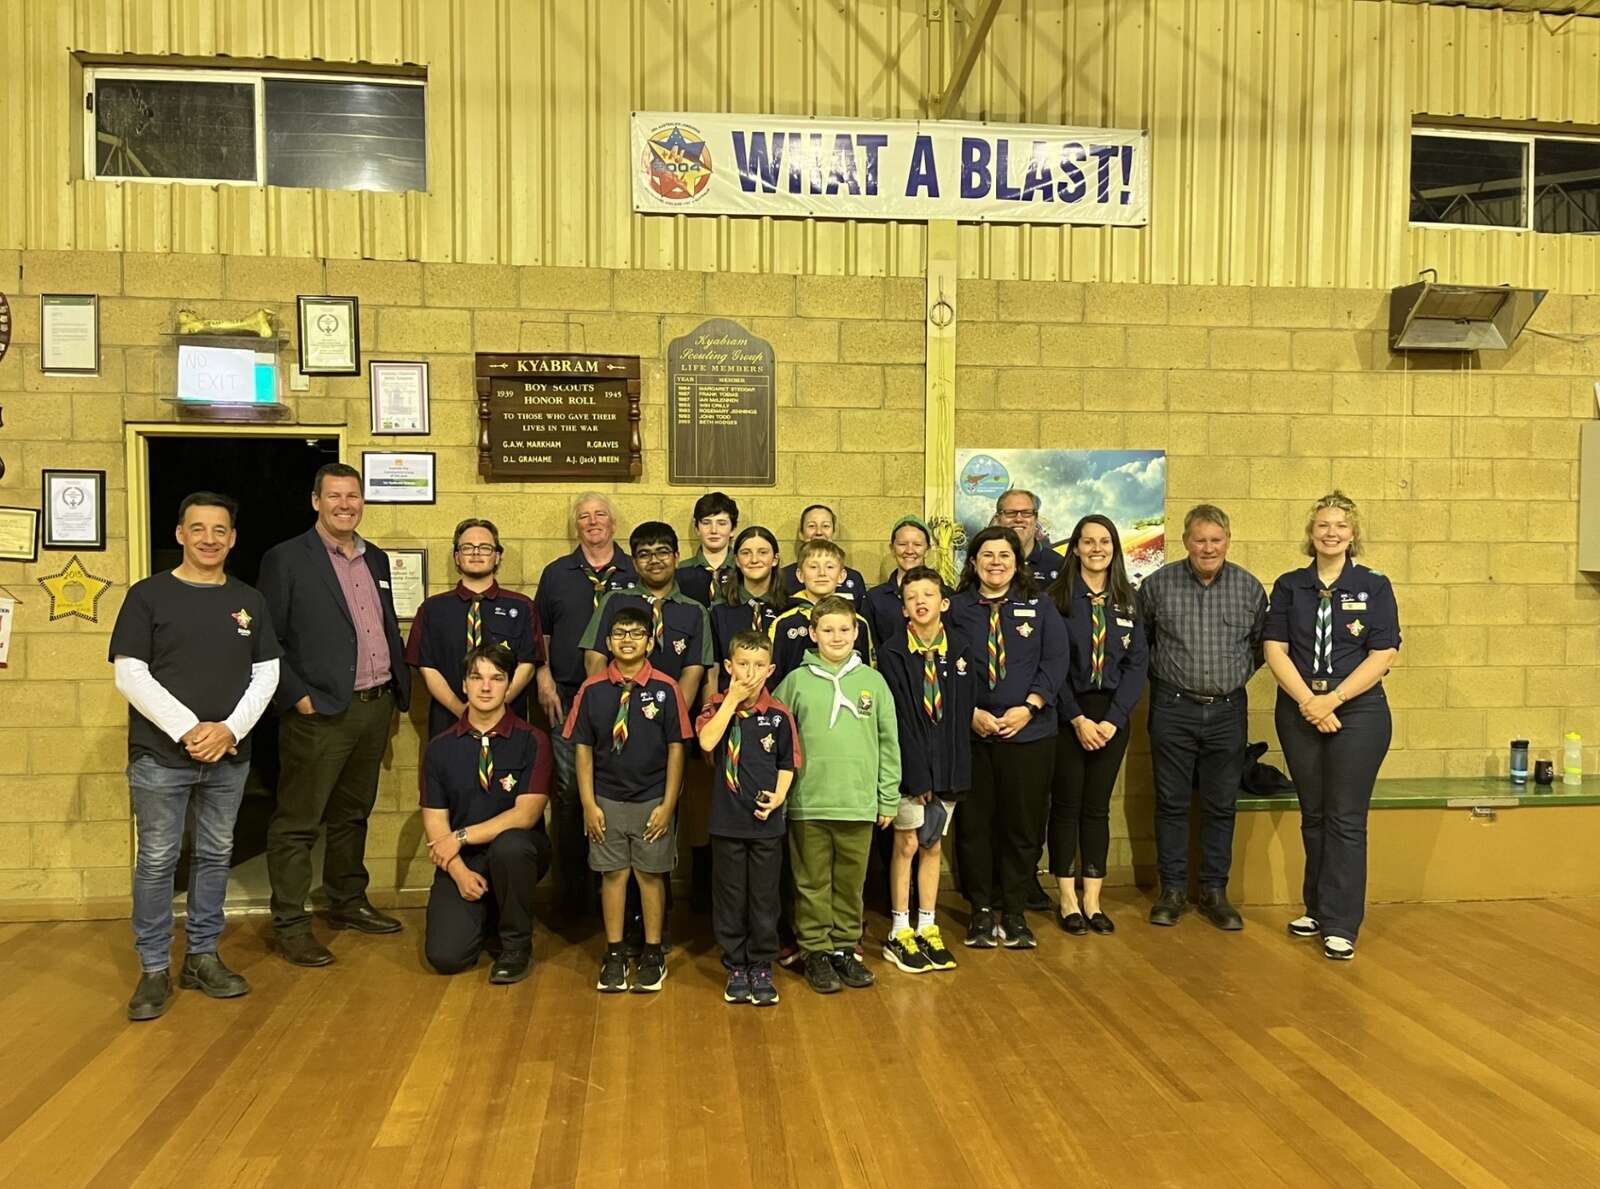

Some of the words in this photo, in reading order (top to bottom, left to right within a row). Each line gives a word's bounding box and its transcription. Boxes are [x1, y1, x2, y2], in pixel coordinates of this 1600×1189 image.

[731, 130, 888, 196] WHAT
[905, 135, 940, 198] A
[960, 136, 1134, 205] BLAST!
[695, 335, 748, 350] Kyabram
[185, 351, 207, 368] NO
[680, 348, 728, 364] Scouting
[731, 350, 763, 365] Group
[517, 360, 599, 373] KYABRAM
[711, 365, 764, 373] MEMBERS
[198, 373, 240, 390] EXIT
[524, 383, 547, 392] BOY
[552, 383, 595, 392] SCOUTS
[496, 390, 514, 398] 1939
[604, 391, 622, 399] 1945
[524, 396, 563, 405] HONOR
[568, 397, 596, 405] ROLL
[503, 412, 515, 420] TO
[517, 412, 543, 420] THOSE
[502, 440, 524, 449] G.A.W.
[526, 440, 562, 449] MARKHAM
[502, 455, 516, 463] D.L.
[518, 455, 552, 463] GRAHAME
